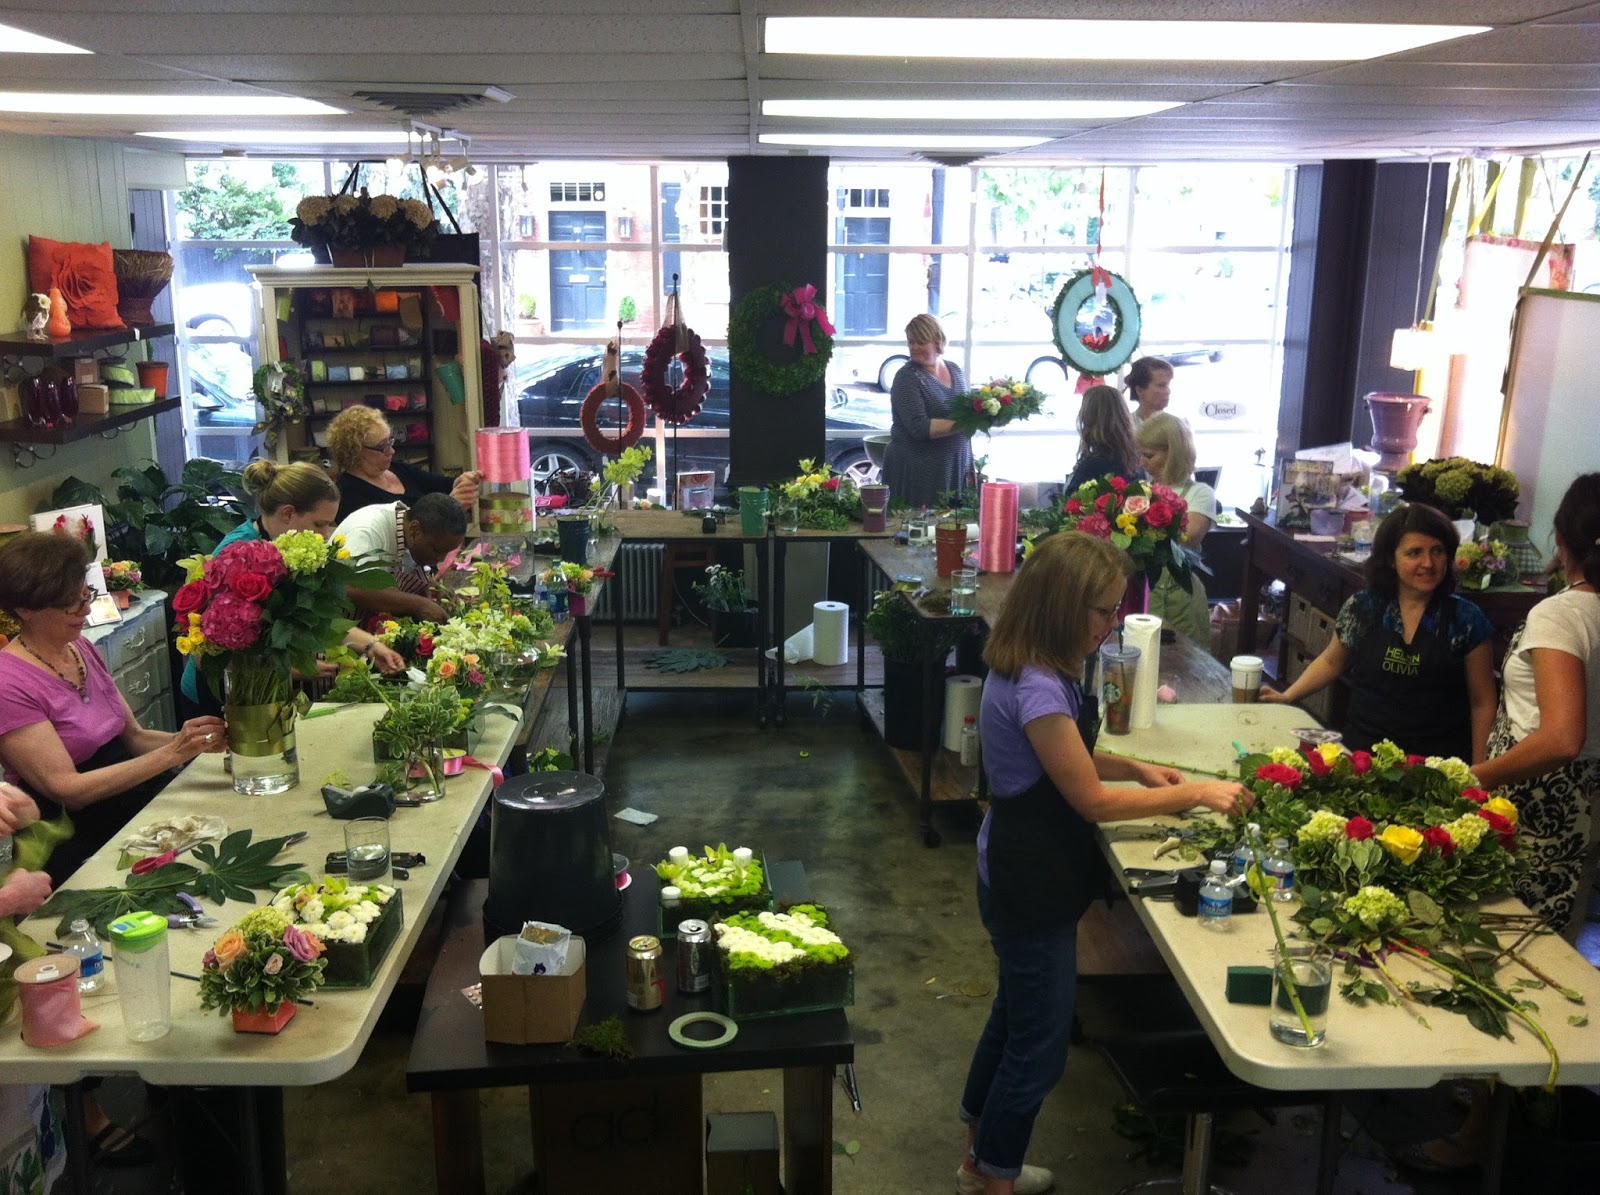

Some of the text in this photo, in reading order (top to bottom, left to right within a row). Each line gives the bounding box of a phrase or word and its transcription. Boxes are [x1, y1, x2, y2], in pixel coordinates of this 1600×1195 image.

[1205, 403, 1236, 417] Closed
[1385, 646, 1420, 663] HELN
[1382, 661, 1418, 675] OLIVIA
